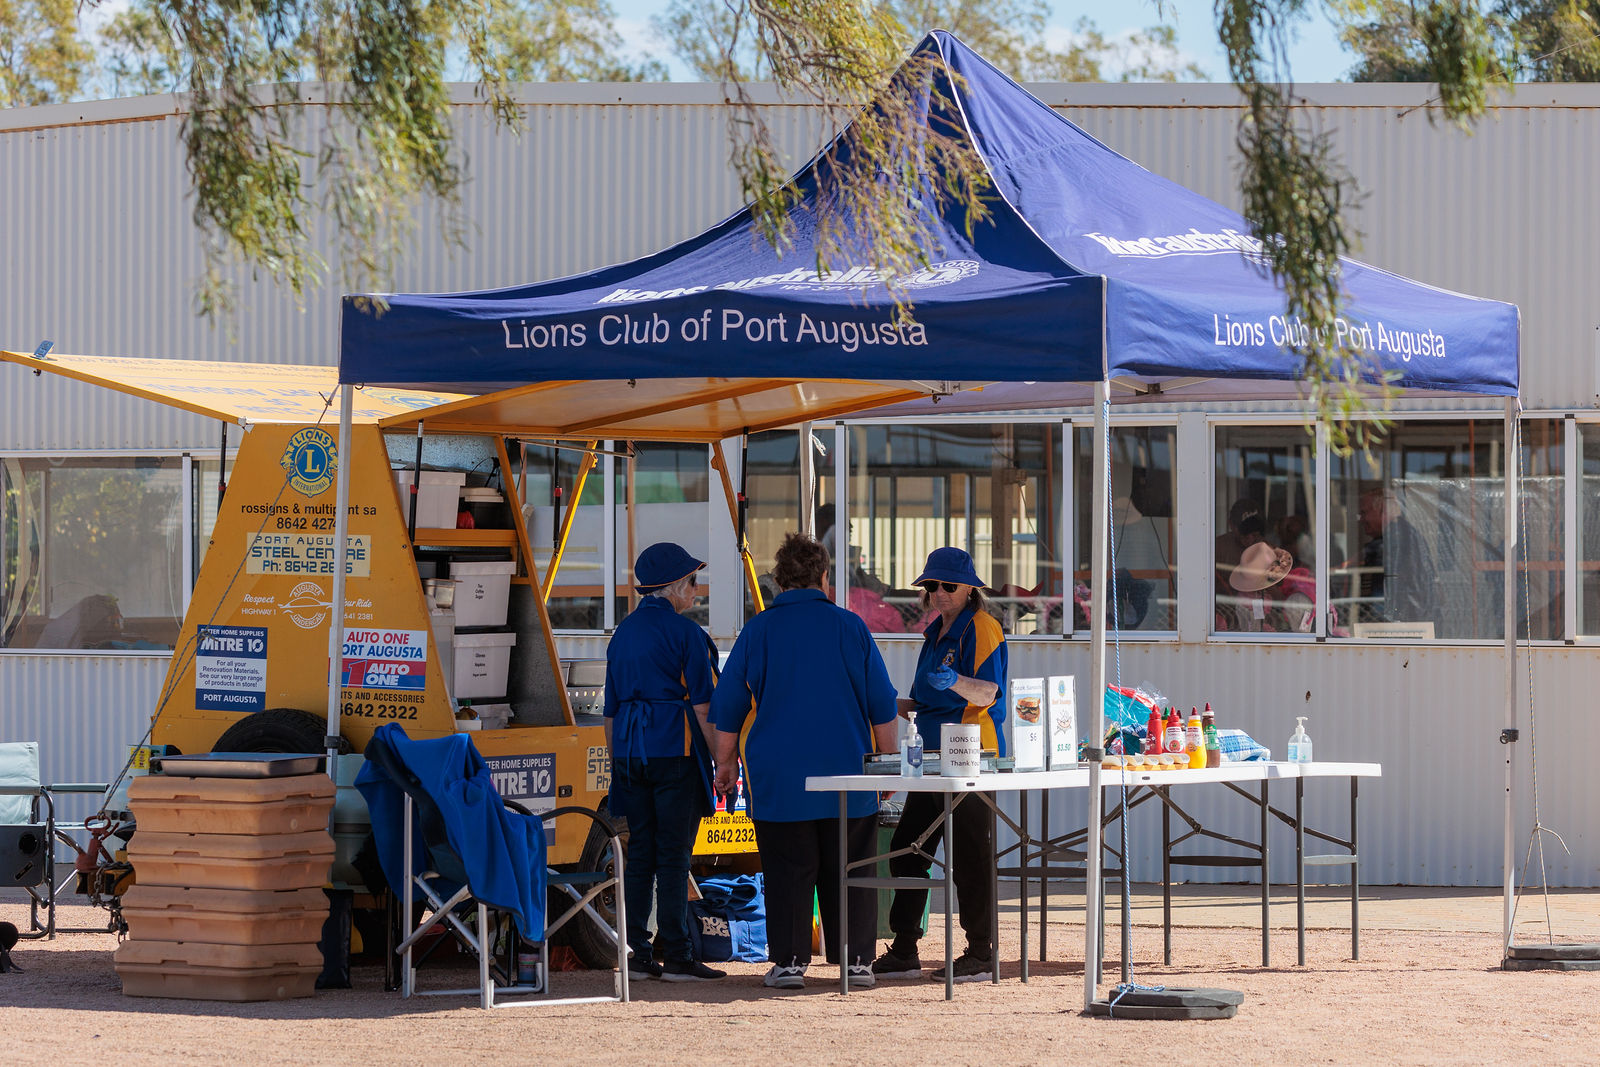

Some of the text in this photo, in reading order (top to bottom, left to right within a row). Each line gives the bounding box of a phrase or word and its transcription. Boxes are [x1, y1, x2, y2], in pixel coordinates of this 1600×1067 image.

[502, 309, 928, 352] Lions Club of Port Augusta
[1214, 314, 1265, 346] Lions
[1269, 315, 1309, 347] Club
[1334, 318, 1374, 350] Port
[1378, 322, 1446, 362] Augusta
[294, 430, 330, 444] LIONS
[304, 449, 320, 472] L
[294, 479, 328, 492] INTERNATIONAL
[241, 503, 288, 516] rossigns
[292, 503, 300, 514] &
[363, 506, 376, 515] sa
[276, 518, 307, 529] 8642
[256, 536, 362, 546] PORT AUGUTA
[252, 546, 366, 560] STEEL CENRE
[262, 560, 282, 572] Ph:
[284, 561, 317, 573] 8642
[293, 584, 321, 597] AUGUSTA
[244, 594, 274, 605] Respect
[356, 598, 372, 608] Ride
[347, 632, 410, 644] AUTO ONE
[248, 638, 264, 652] 10
[342, 644, 422, 658] ORT AUGUSTA
[368, 663, 410, 674] AUTO
[366, 674, 400, 686] ONE
[204, 694, 257, 704] PORT AUGUSTA
[355, 692, 370, 700] AND
[374, 693, 424, 704] ACCESSORIES
[378, 704, 418, 720] 2322
[1057, 744, 1070, 752] $3.50
[501, 760, 521, 769] HOME
[522, 757, 552, 768] SUPPLIES
[588, 758, 611, 774] STE
[491, 770, 550, 796] ITRE 10
[703, 816, 719, 825] PARTS
[720, 816, 730, 825] AND
[708, 828, 755, 844] 8642 232
